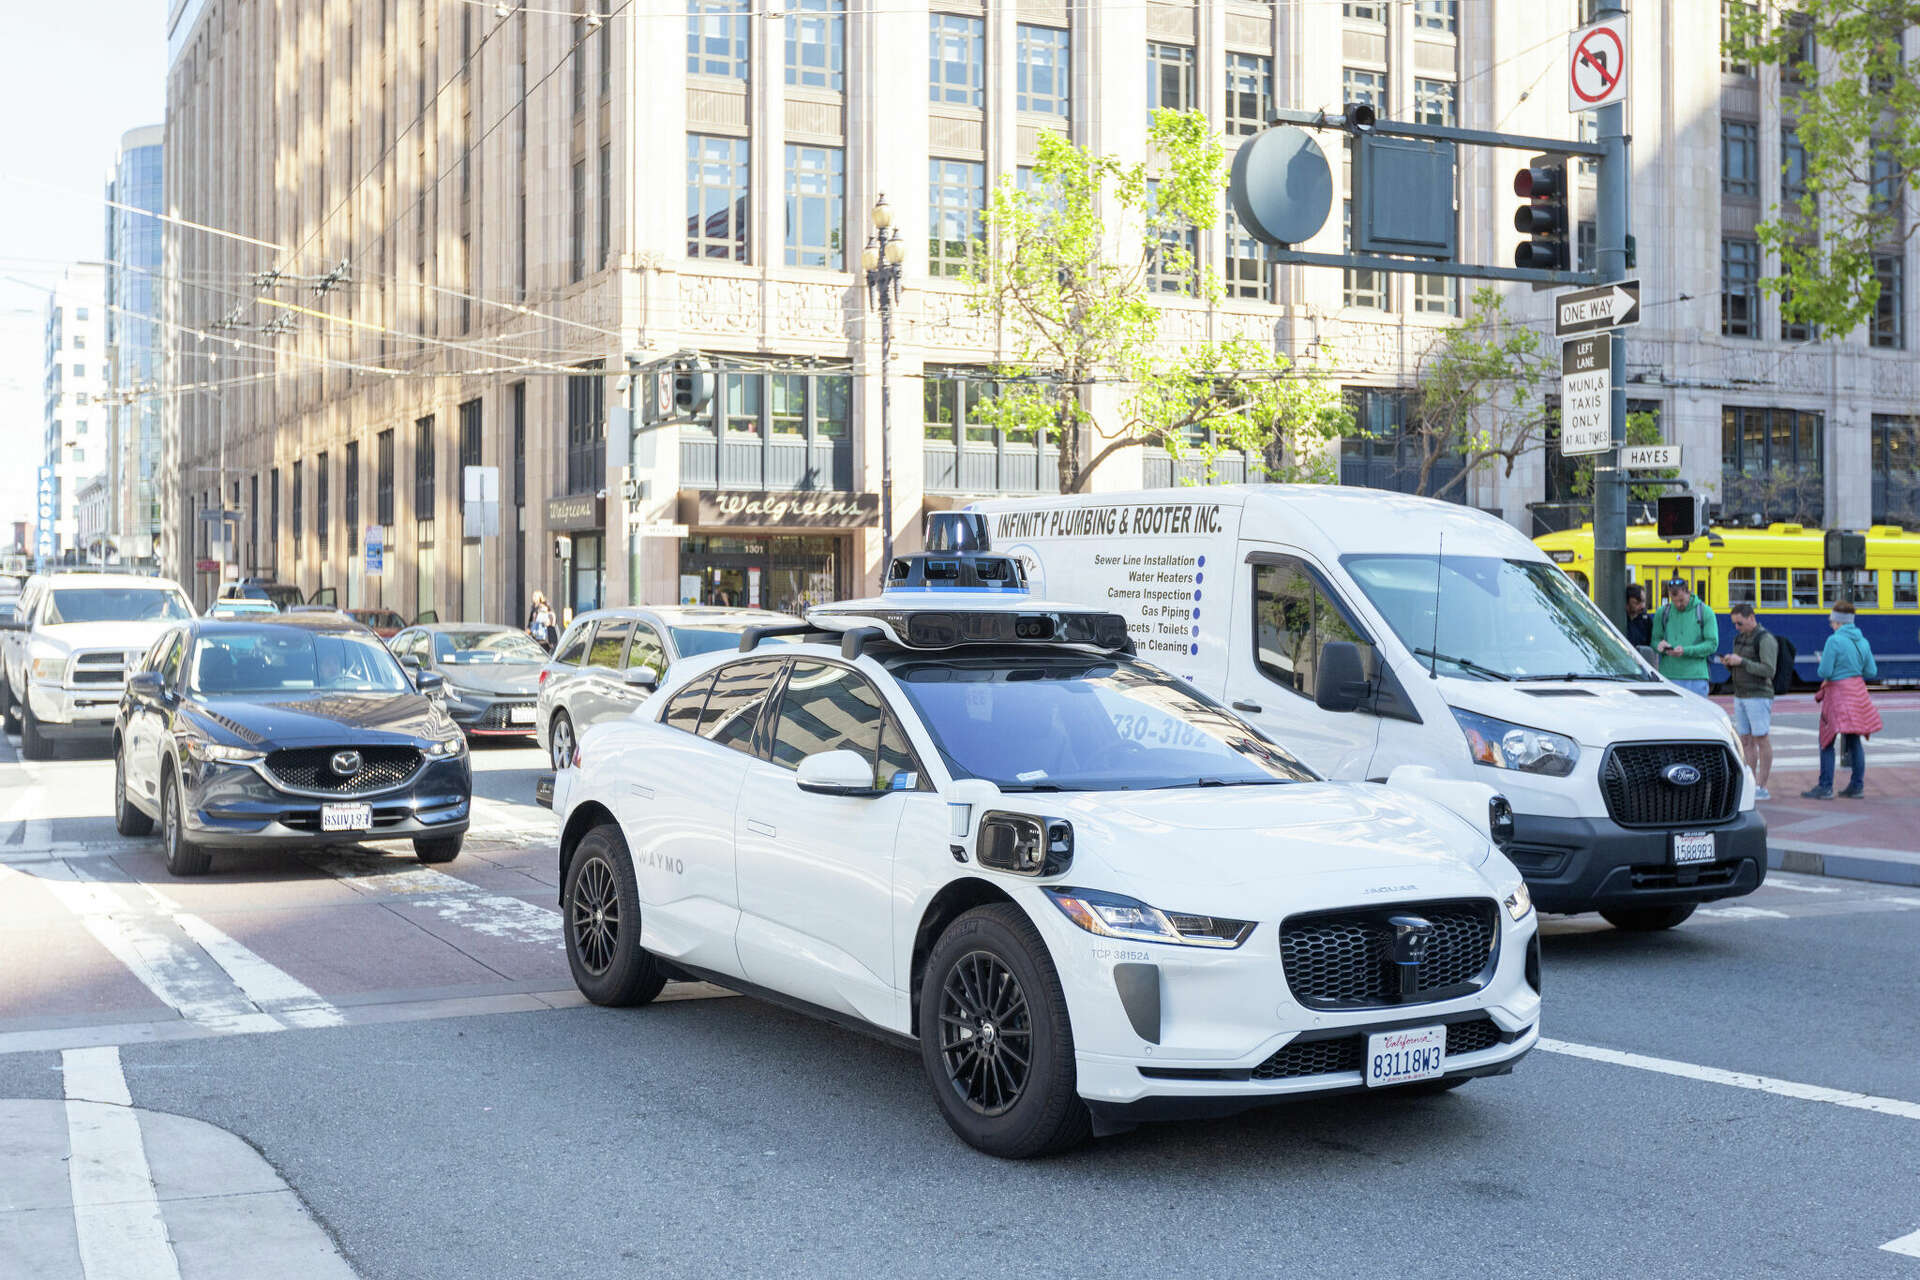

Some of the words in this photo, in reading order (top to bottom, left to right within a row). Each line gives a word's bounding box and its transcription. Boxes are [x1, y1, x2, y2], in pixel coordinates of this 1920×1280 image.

[1564, 303, 1586, 323] ONE
[1590, 298, 1613, 318] WAY
[1577, 342, 1593, 356] LEFT
[1576, 356, 1594, 369] LANE
[1568, 379, 1595, 392] MUNI
[1597, 378, 1604, 389] &
[1571, 395, 1601, 410] TAXIS
[1572, 413, 1600, 429] ONLY
[1566, 434, 1574, 446] AT
[1575, 433, 1587, 446] ALL
[1587, 431, 1608, 445] TIMES
[1631, 450, 1669, 464] HAYES
[550, 502, 591, 524] Walgreens
[716, 495, 864, 521] Walgreens
[997, 511, 1049, 538] INFINITY
[1050, 506, 1117, 537] PLUMBING
[1119, 509, 1128, 535] &
[1133, 506, 1192, 535] ROOTER
[1194, 505, 1223, 533] INC.
[744, 544, 764, 554] 1301
[1094, 554, 1121, 565] Sewer
[1123, 554, 1141, 566] Line
[1144, 554, 1195, 566] Installation
[1129, 571, 1154, 582] Water
[1157, 571, 1193, 583] Heaters
[1108, 587, 1141, 599] Camera
[1144, 588, 1191, 601] Inspection
[1141, 605, 1158, 616] Gas
[1161, 605, 1190, 620] Piping
[1158, 622, 1188, 635] Toilets
[1148, 639, 1188, 655] Cleaning
[1677, 770, 1696, 781] Ford
[639, 848, 684, 875] WAYMO
[1363, 884, 1418, 895] JAGUAR
[1091, 949, 1111, 960] TCP
[1112, 950, 1150, 960] 38152A
[1385, 1034, 1432, 1049] California
[1373, 1046, 1441, 1078] 83118W3
